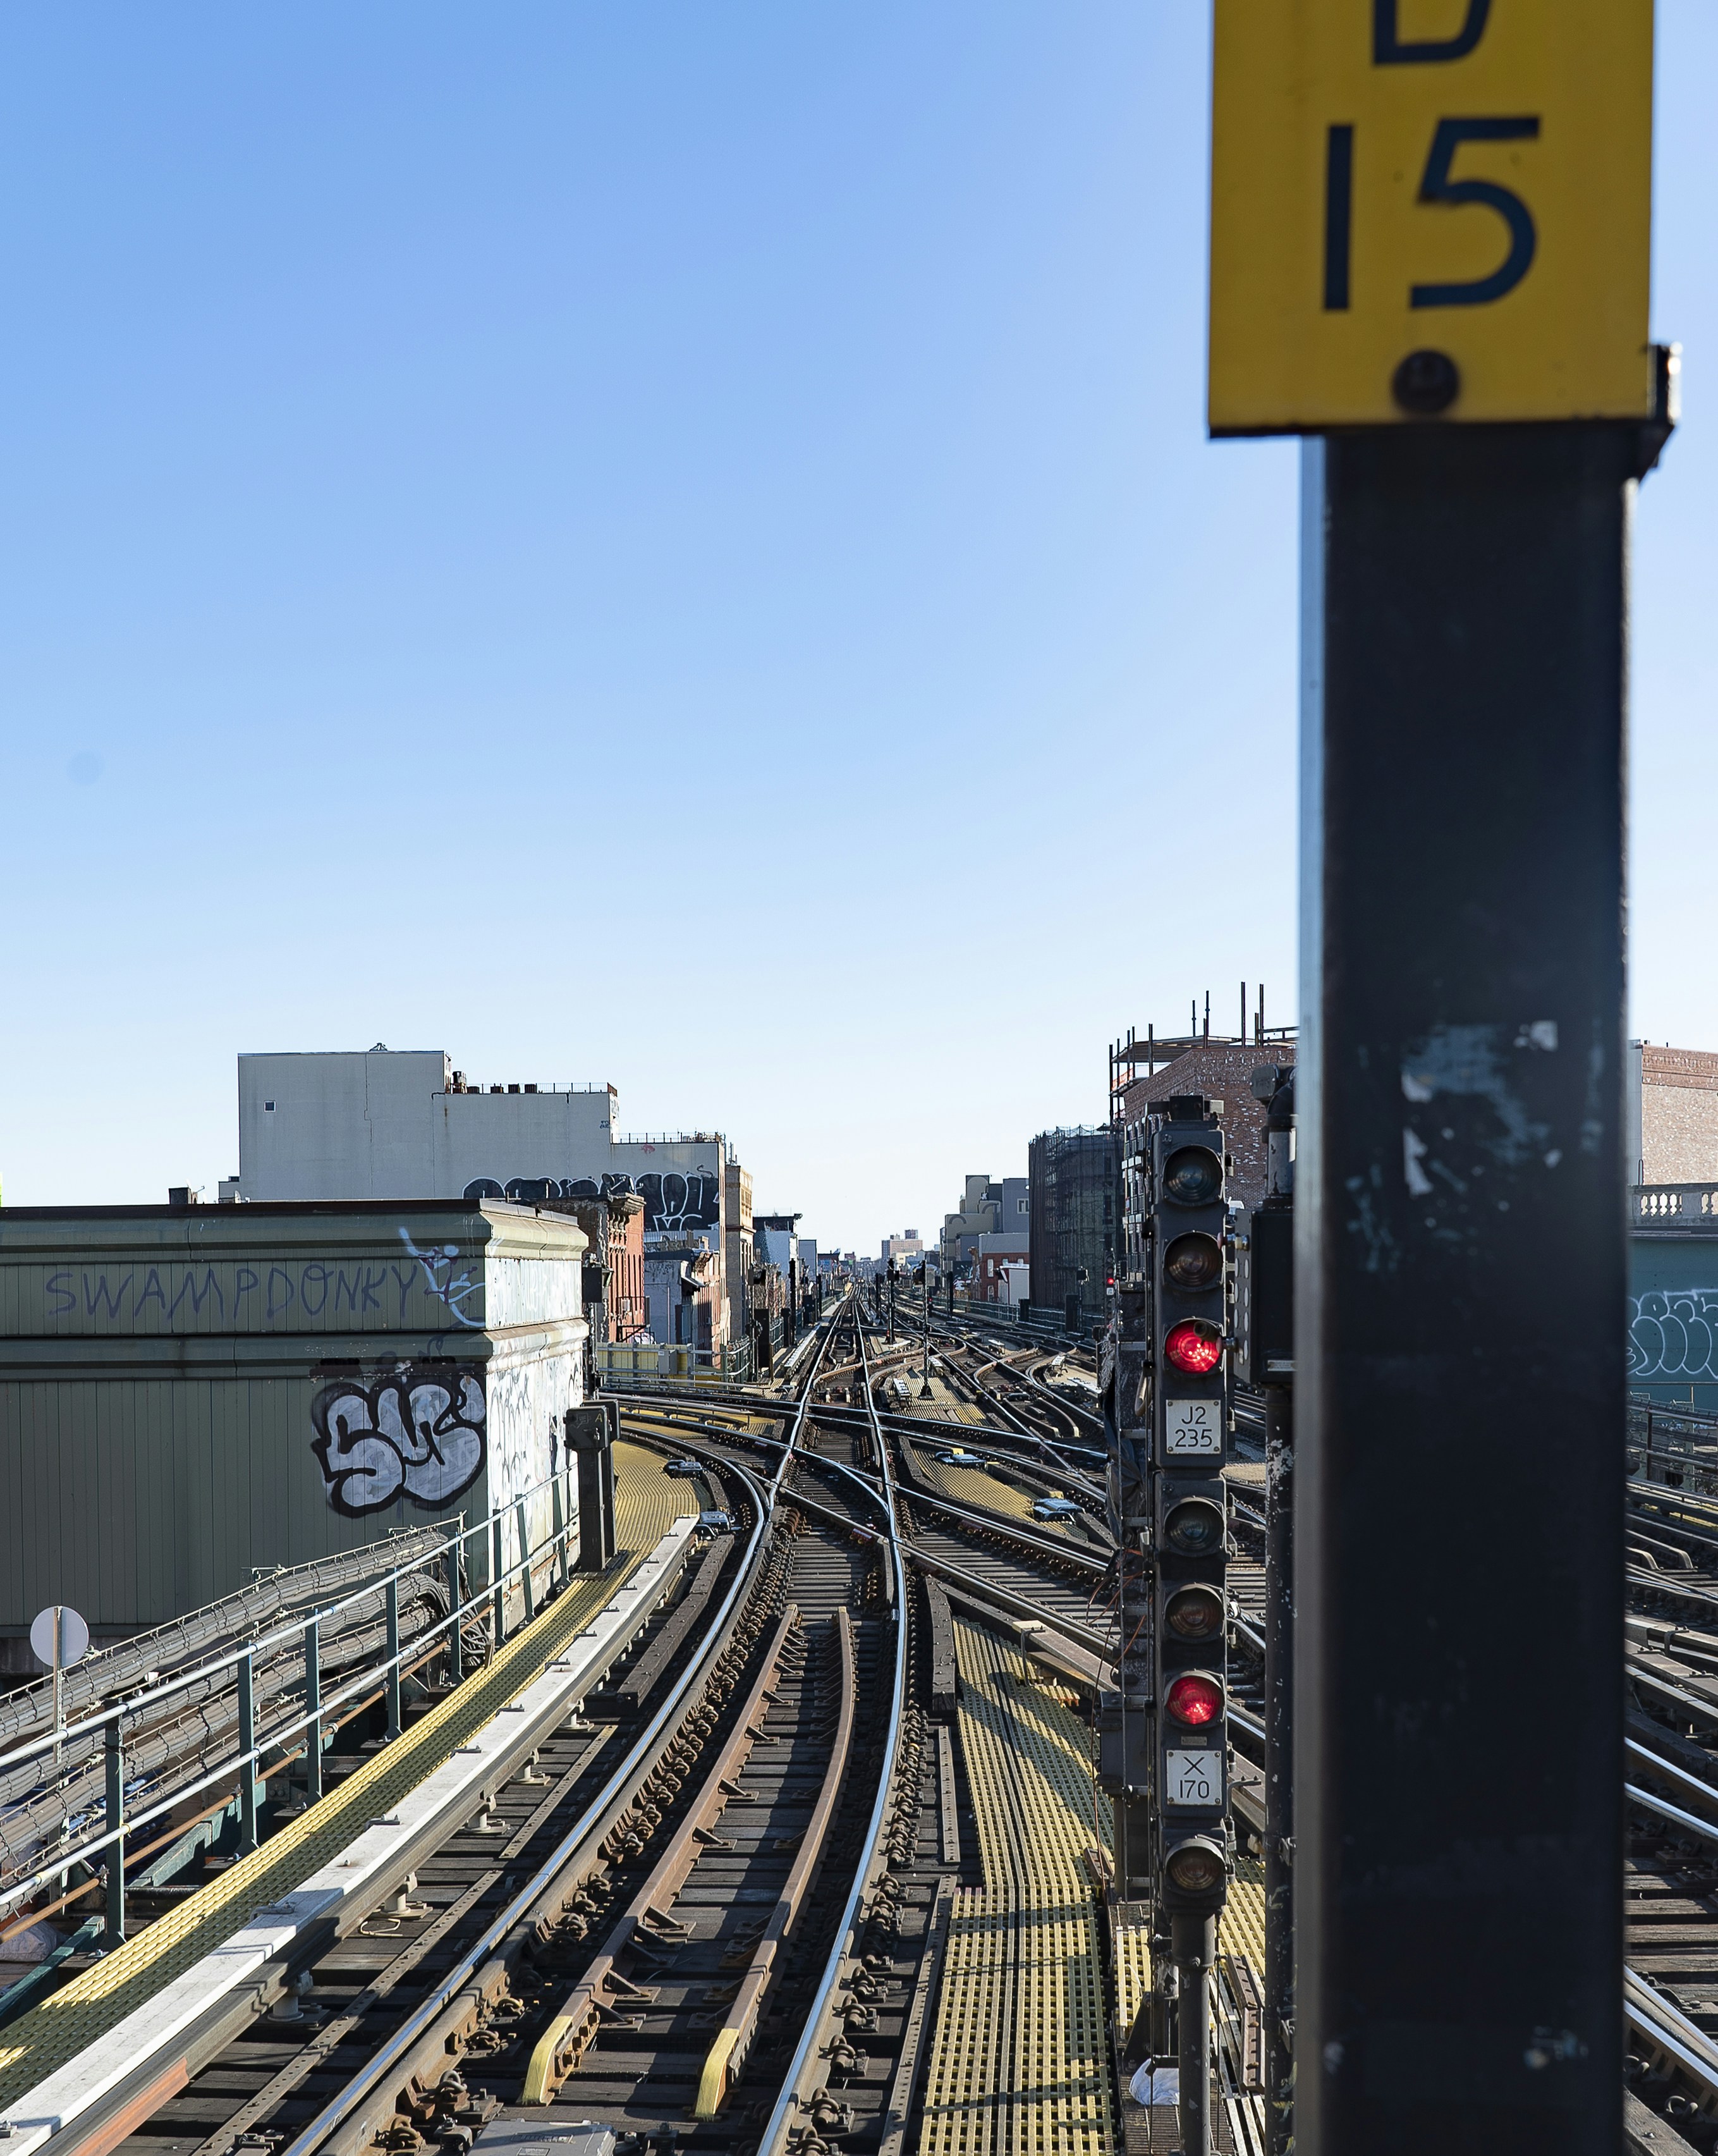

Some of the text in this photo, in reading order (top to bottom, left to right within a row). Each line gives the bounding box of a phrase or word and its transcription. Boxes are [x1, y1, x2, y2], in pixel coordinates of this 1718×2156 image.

[1323, 114, 1542, 312] 15
[46, 1264, 417, 1320] SWAMPDONKY
[1181, 1406, 1207, 1424] J2
[1174, 1428, 1213, 1448] 235
[1183, 1756, 1205, 1775] X
[1179, 1779, 1210, 1799] 170
